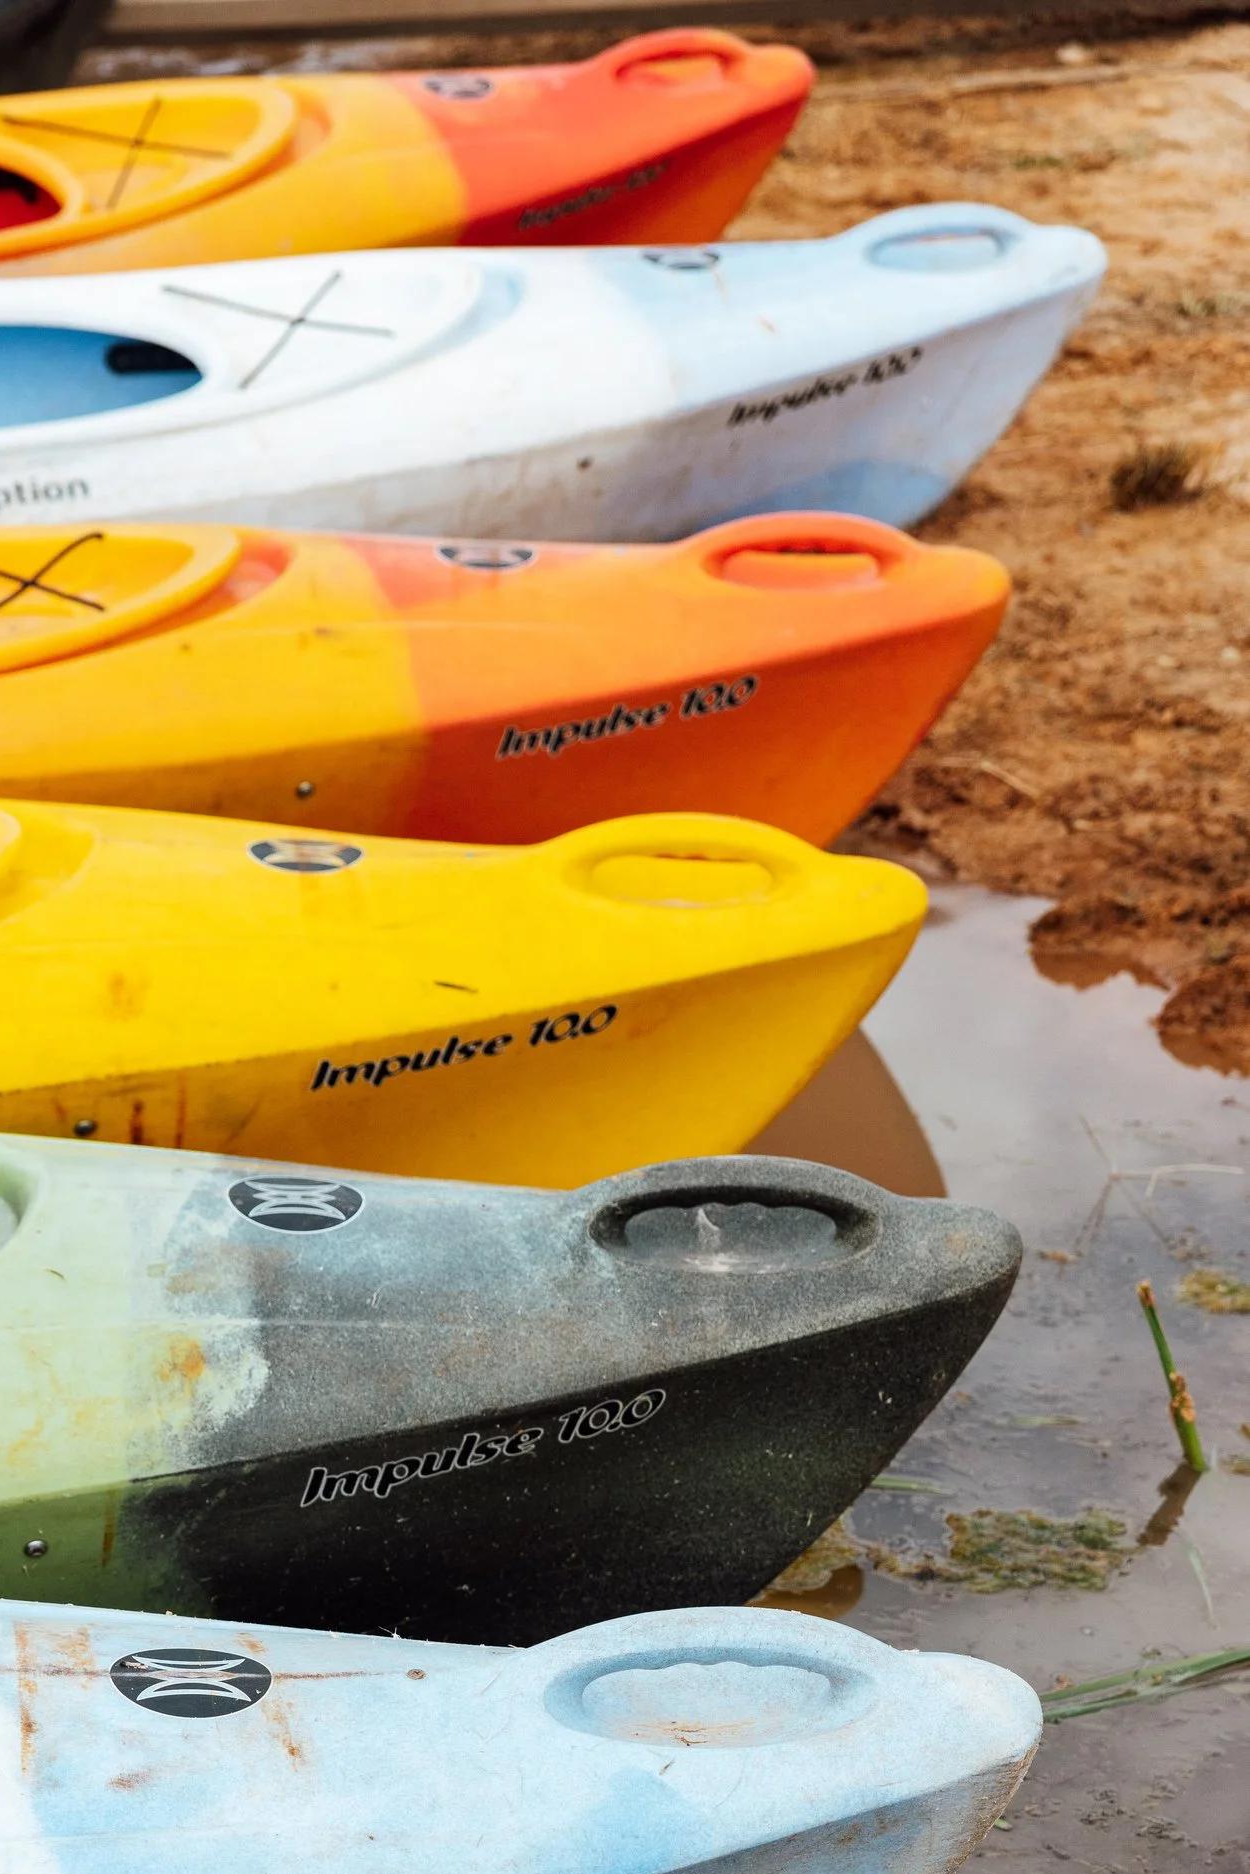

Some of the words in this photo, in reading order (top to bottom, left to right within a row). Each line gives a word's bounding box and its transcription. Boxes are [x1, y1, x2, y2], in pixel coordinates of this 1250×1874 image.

[495, 702, 671, 761] Impulse
[310, 1033, 513, 1092] Impulse
[528, 1003, 618, 1048] 10.0
[300, 1427, 544, 1508] Impulse
[557, 1388, 667, 1444] 10.0
